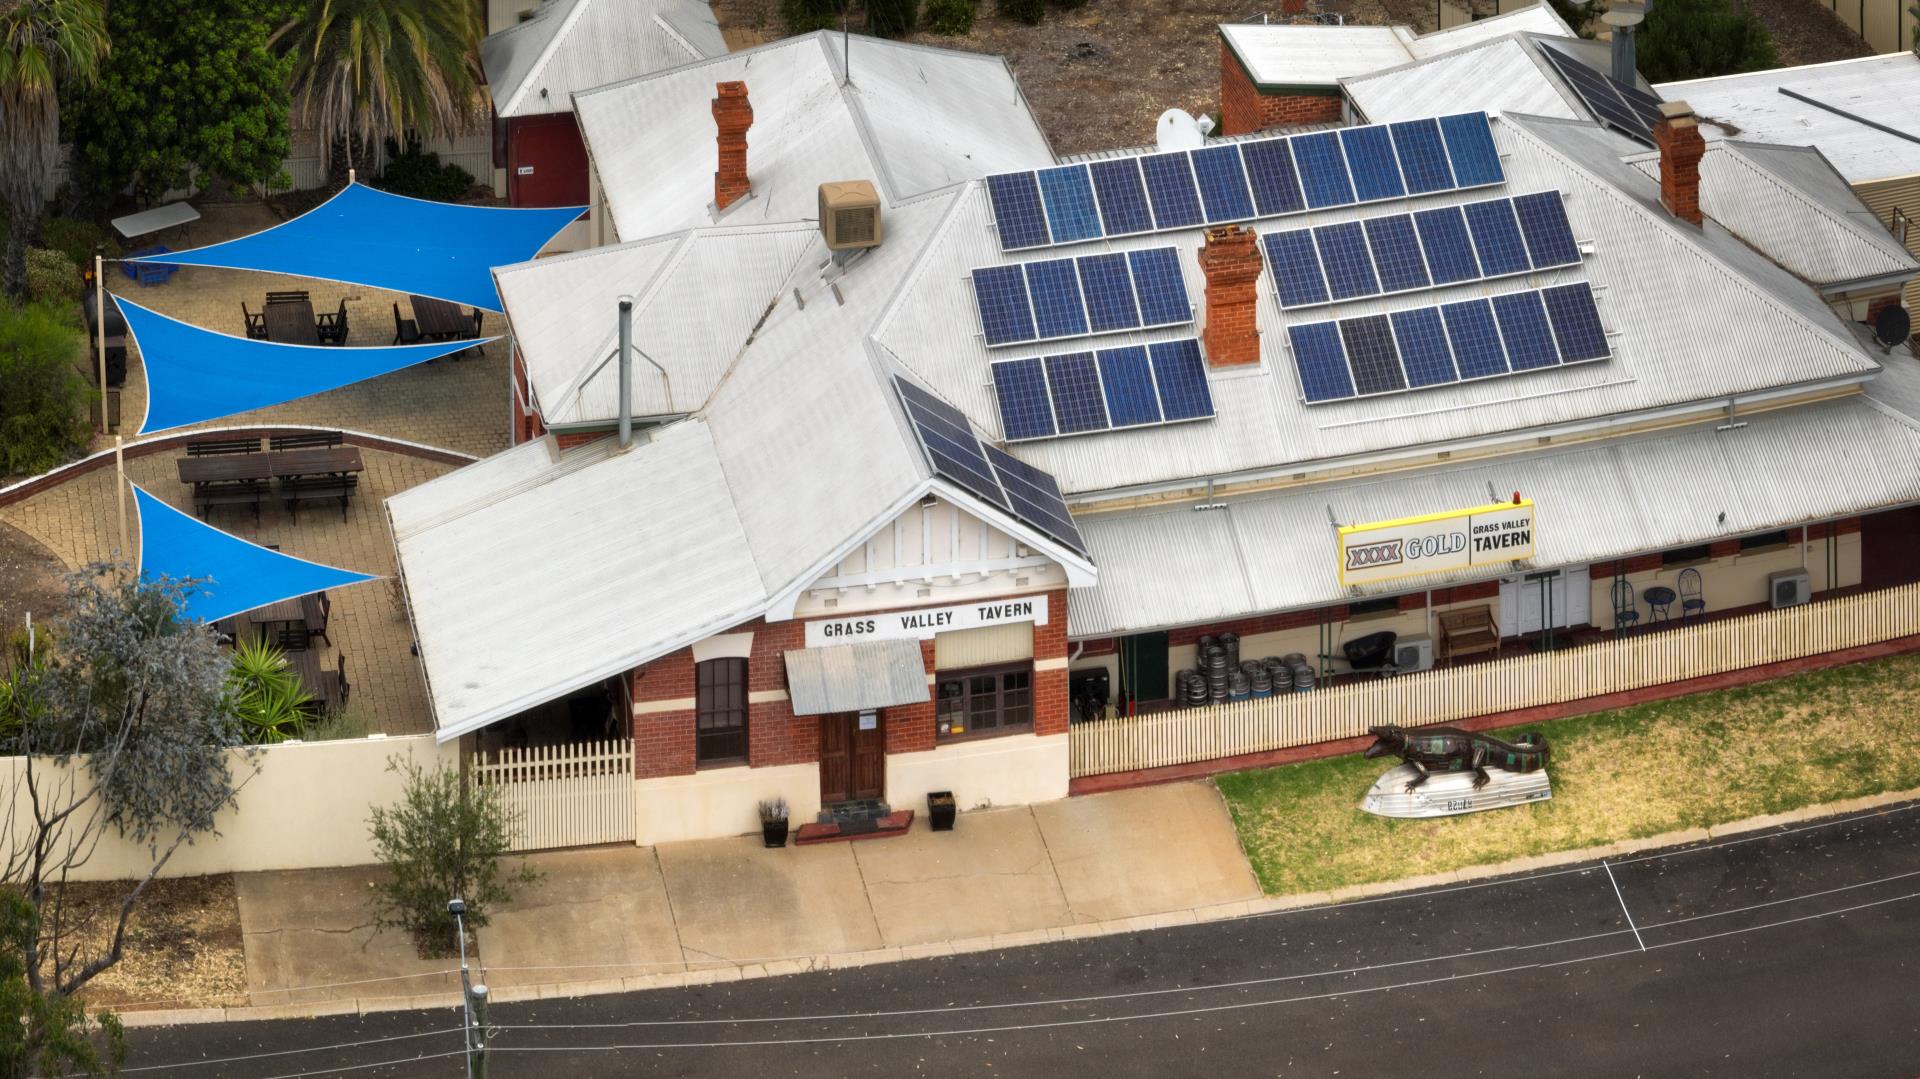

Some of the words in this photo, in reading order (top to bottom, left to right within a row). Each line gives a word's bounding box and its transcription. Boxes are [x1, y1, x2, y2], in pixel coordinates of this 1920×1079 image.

[1473, 523, 1499, 534] GRASS
[1502, 518, 1531, 530] VALLEY
[1351, 543, 1398, 566] XXXX
[1405, 532, 1466, 559] GOLD
[1474, 530, 1530, 552] TAVERN
[824, 620, 875, 637] GRASS
[901, 611, 953, 629] VALLEY
[978, 601, 1032, 620] TAVERN
